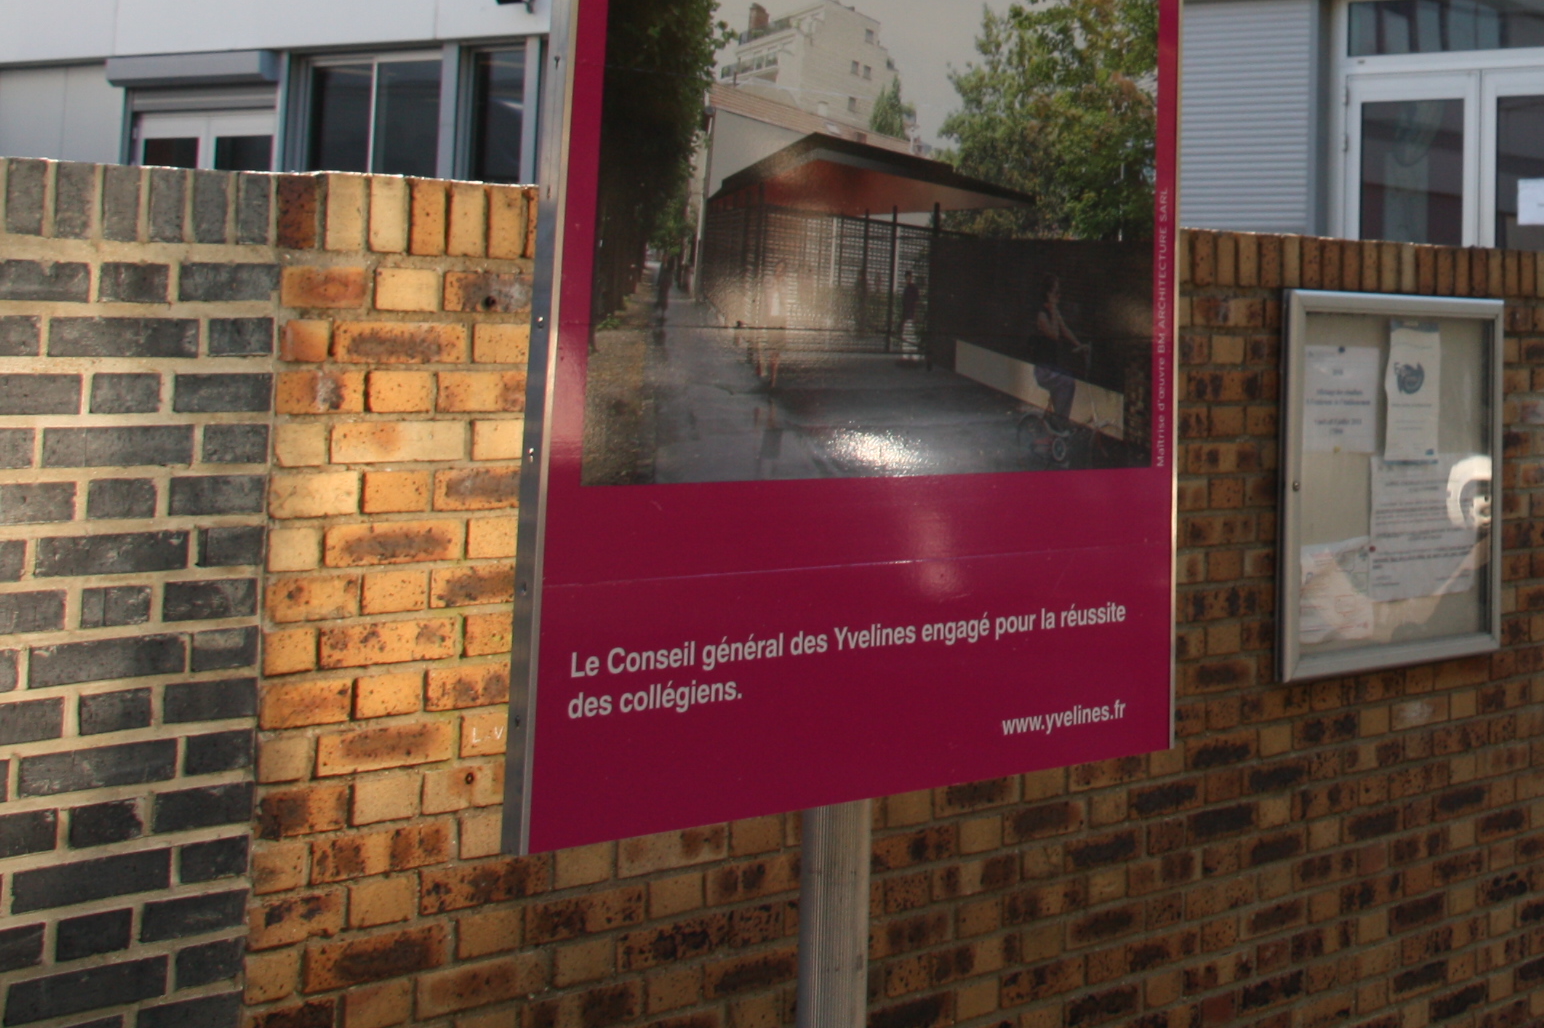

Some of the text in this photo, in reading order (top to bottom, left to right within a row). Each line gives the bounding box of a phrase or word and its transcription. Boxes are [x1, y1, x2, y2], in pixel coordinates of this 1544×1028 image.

[1160, 187, 1168, 221] SARL
[1158, 226, 1168, 329] ARCHITECTURE
[1157, 333, 1166, 354] BM
[1157, 414, 1165, 467] Maîtrise
[570, 602, 1126, 678] Le Conseil général des Yvelines engagé pour la réussite
[567, 677, 743, 720] des collégiens.
[1001, 698, 1126, 736] www.yvelines.fr
